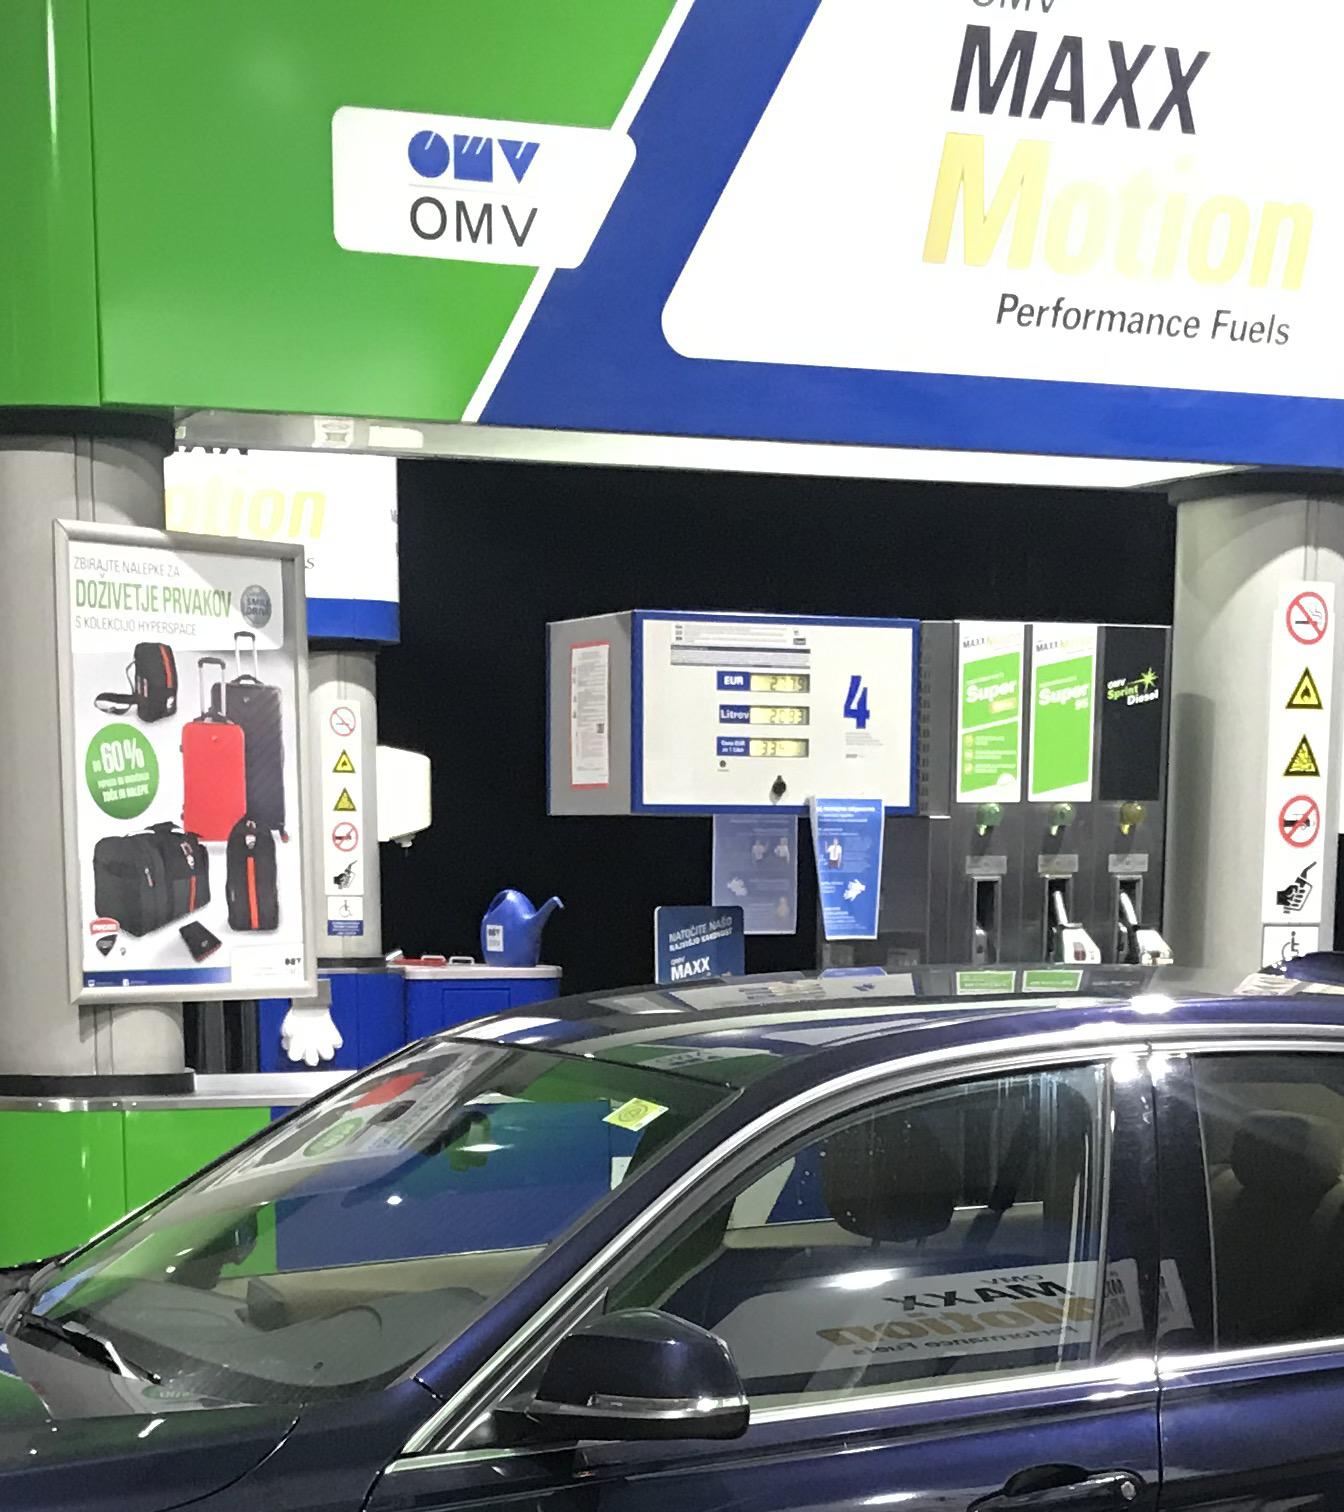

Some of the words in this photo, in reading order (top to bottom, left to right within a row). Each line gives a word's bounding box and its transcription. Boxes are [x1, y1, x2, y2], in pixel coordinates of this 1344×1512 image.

[950, 24, 1211, 134] MAXX
[410, 196, 539, 248] OMV
[922, 131, 1315, 292] Motion
[996, 293, 1201, 338] Performance
[1211, 309, 1291, 345] Fuels
[73, 556, 120, 573] ZBIRAJTE
[122, 560, 164, 577] NALEPKE
[167, 565, 180, 577] ZA
[75, 573, 159, 613] DOŽIVETJE
[162, 586, 232, 618] PRVAKOV
[84, 616, 136, 632] KOLEKCIJO
[138, 619, 197, 636] HYPERSPACE
[723, 675, 744, 686] EUR
[966, 680, 1017, 703] Super
[1107, 684, 1139, 701] Sprint
[843, 675, 871, 729] 4
[1039, 684, 1089, 706] Super
[1127, 689, 1159, 706] Diesel
[100, 737, 145, 774] 60%
[671, 956, 710, 981] MAXX
